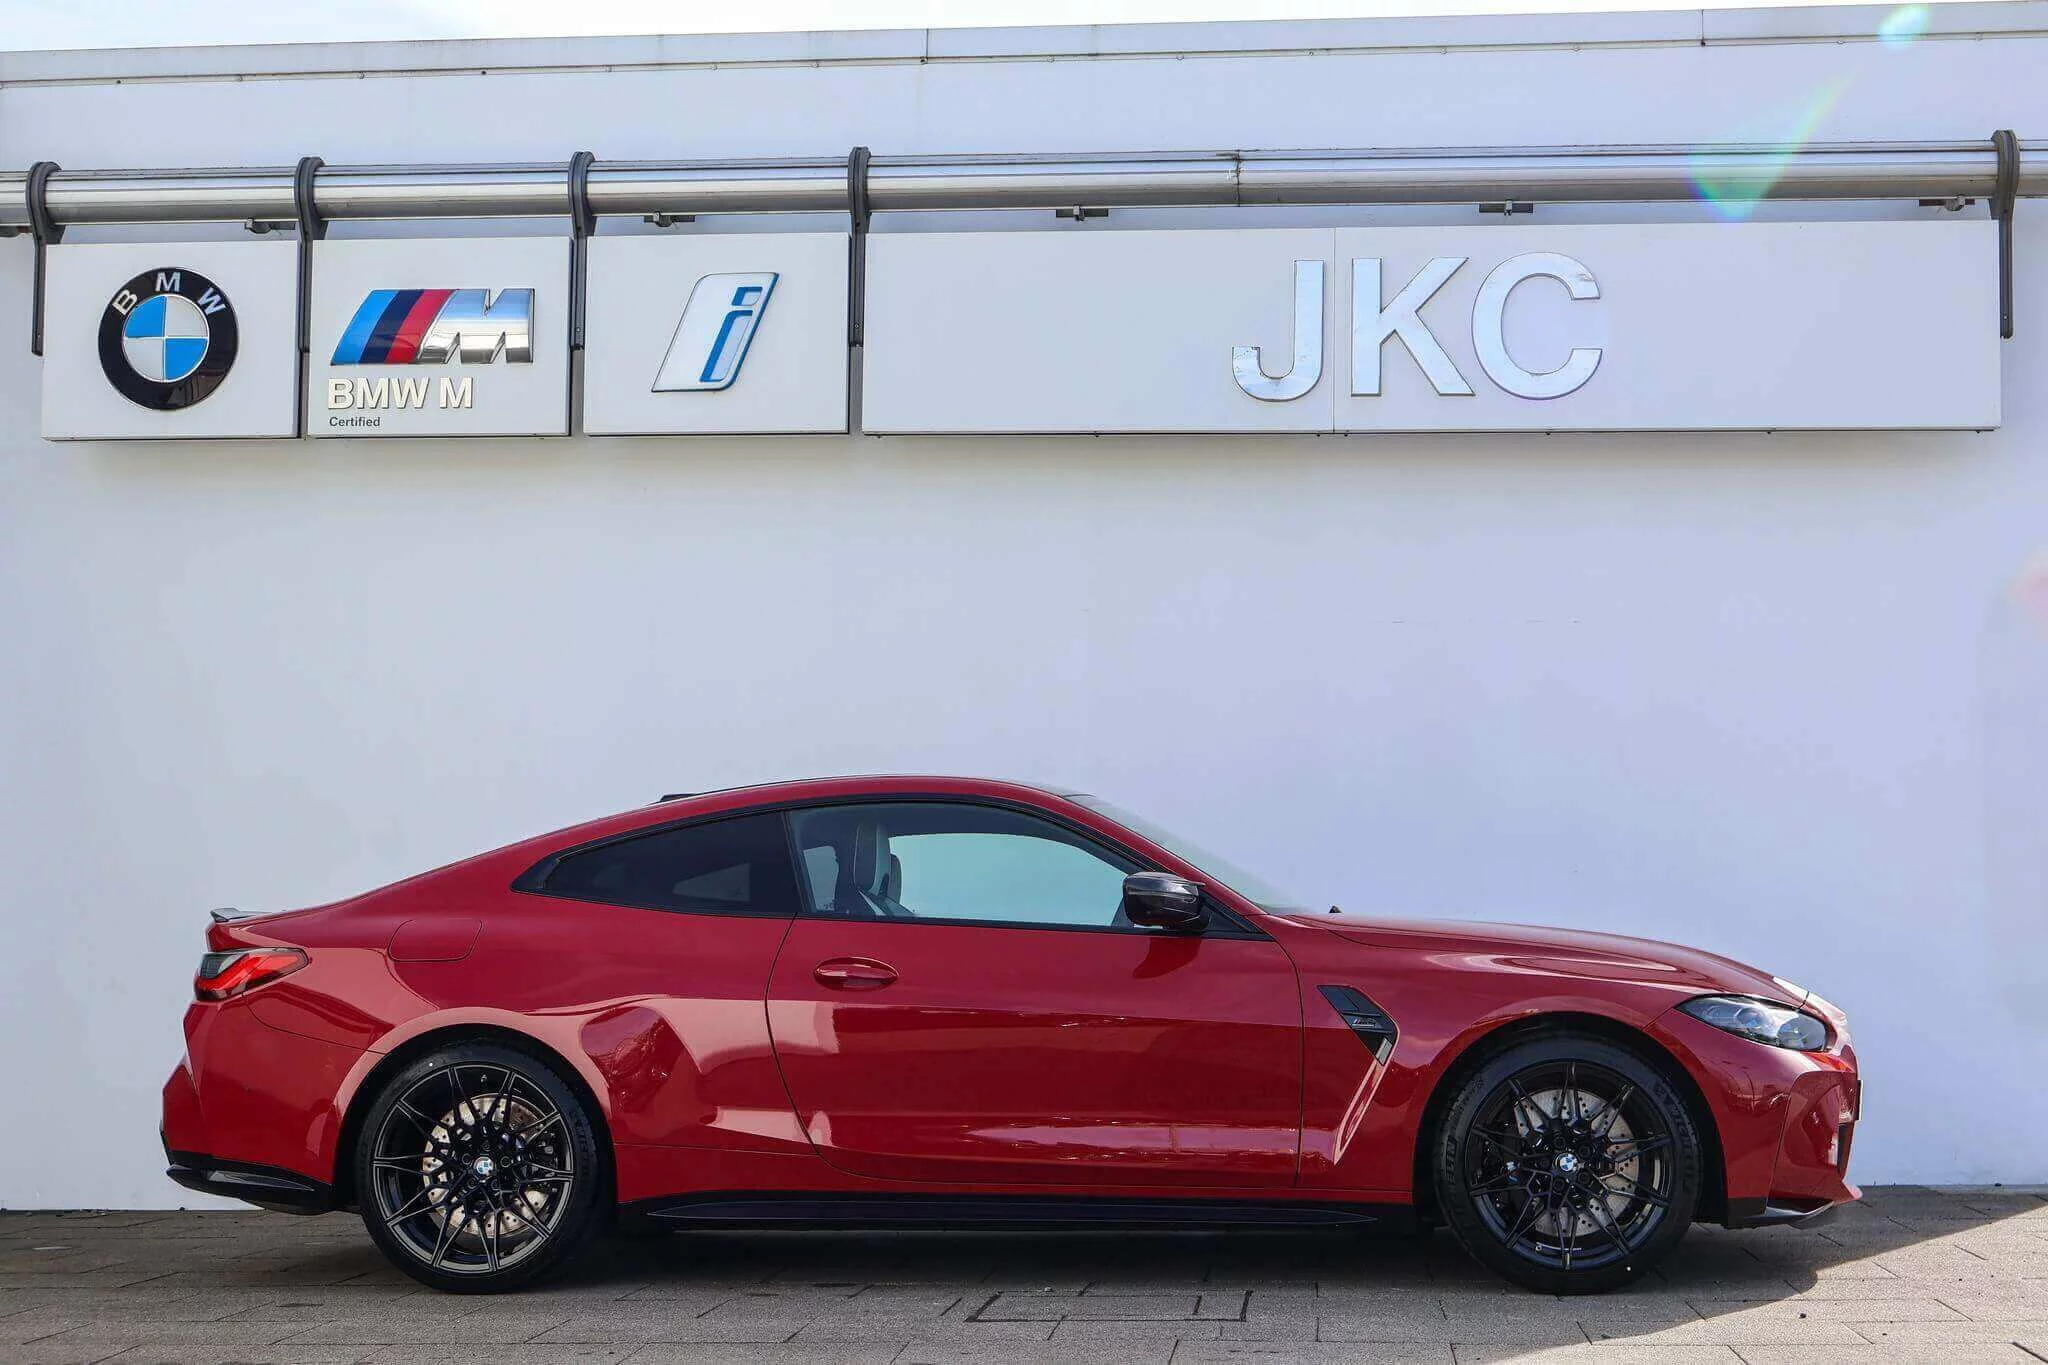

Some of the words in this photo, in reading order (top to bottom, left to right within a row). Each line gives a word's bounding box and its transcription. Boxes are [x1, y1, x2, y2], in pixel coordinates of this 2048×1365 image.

[112, 271, 227, 315] BMW
[416, 288, 535, 365] M
[1232, 252, 1603, 402] JKC
[328, 377, 430, 410] BMW
[440, 377, 473, 409] M
[329, 416, 381, 427] Certified
